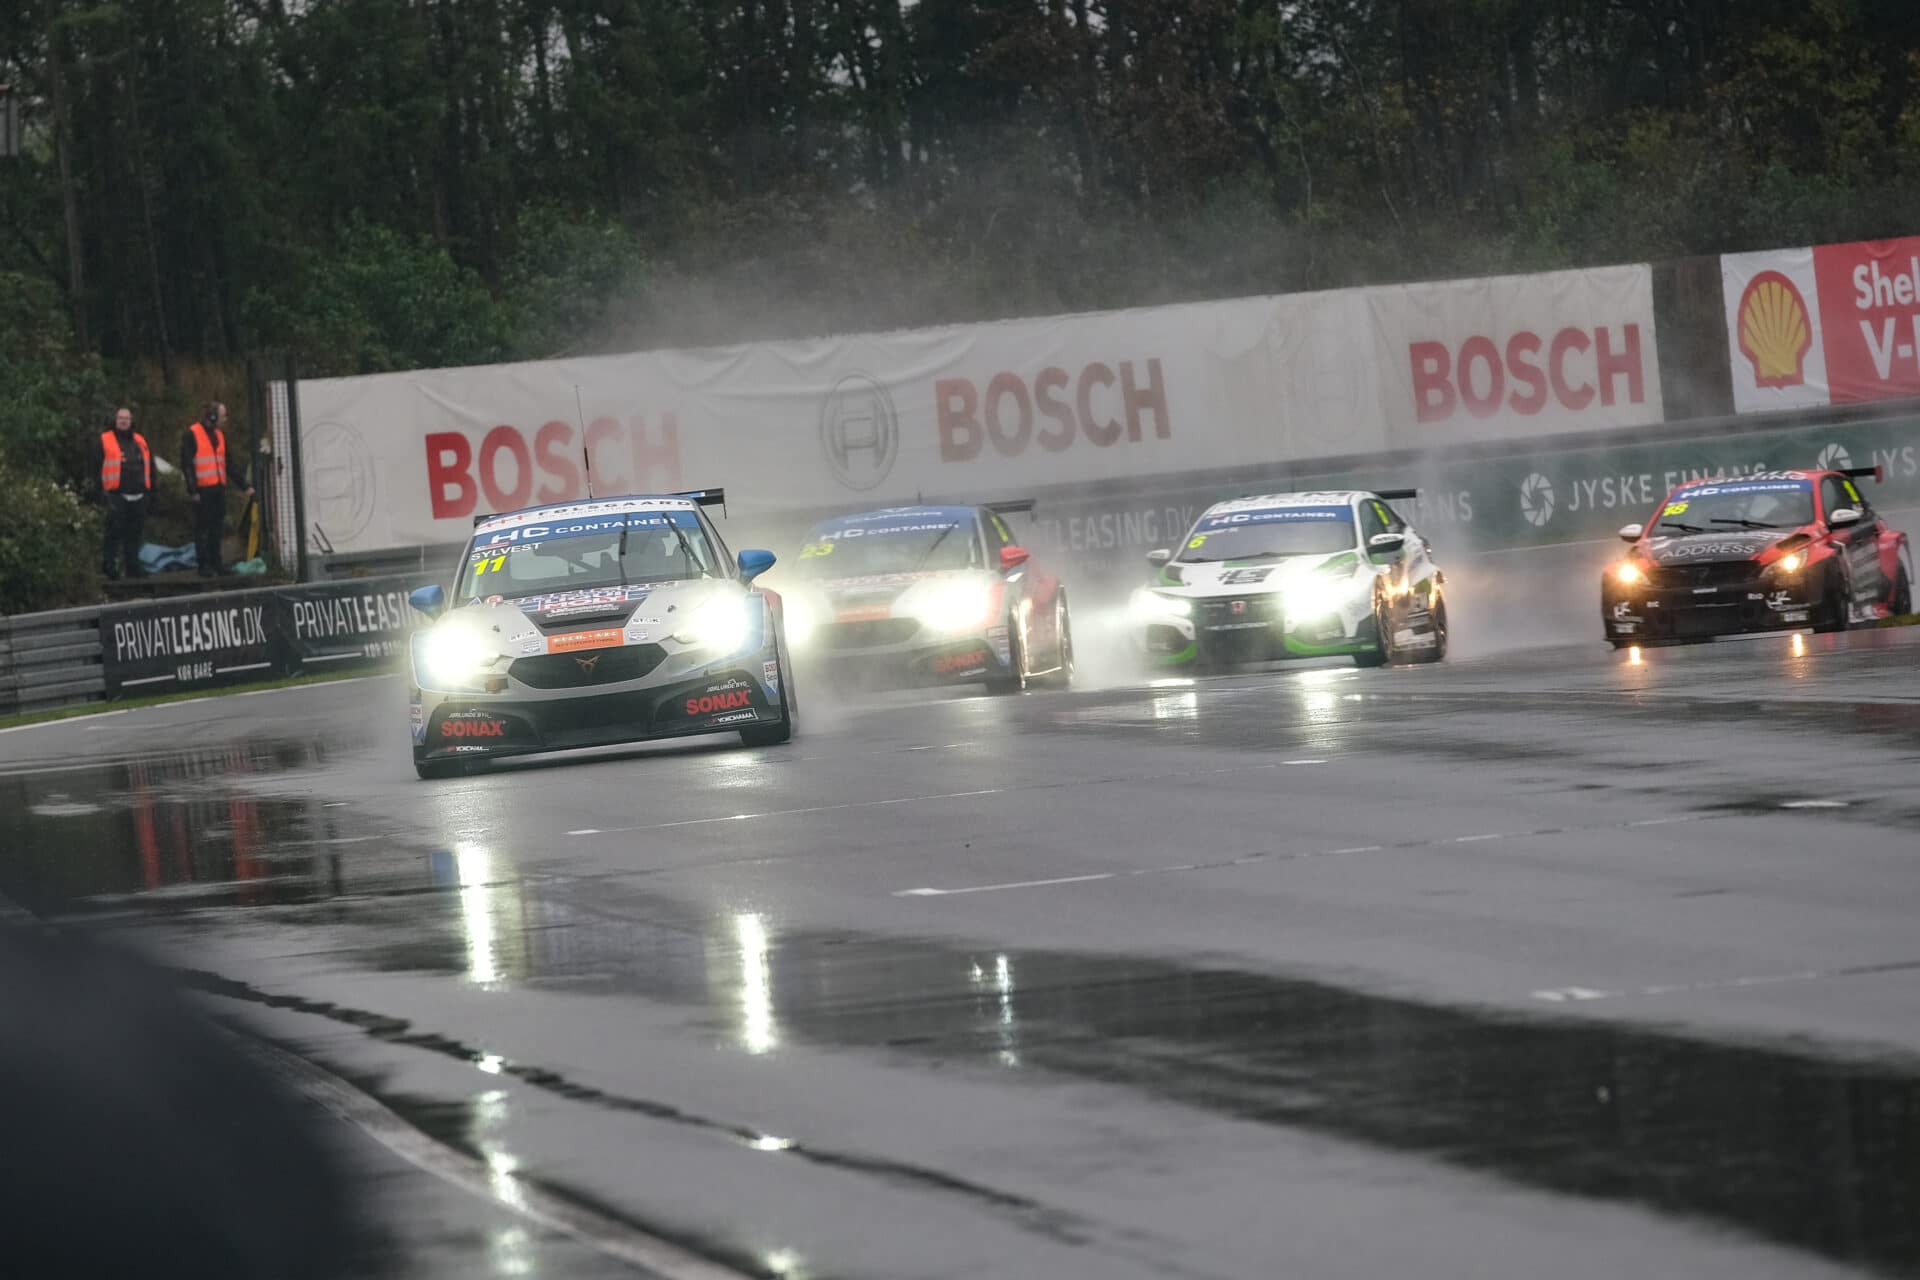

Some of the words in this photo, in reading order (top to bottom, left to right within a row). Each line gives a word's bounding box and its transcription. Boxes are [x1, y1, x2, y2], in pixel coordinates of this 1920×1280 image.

[1854, 256, 1920, 310] Shel
[1409, 323, 1645, 424] BOSCH
[935, 357, 1171, 464] BOSCH
[424, 410, 684, 520] BOSCH
[1568, 474, 1654, 511] JYSKE
[1681, 488, 1720, 498] HC
[1721, 484, 1800, 493] CONTAINER
[1210, 514, 1250, 526] HC
[491, 527, 550, 545] HC
[555, 518, 676, 534] CONTAINER
[820, 529, 864, 541] HC
[470, 542, 542, 561] SYLVEST
[1660, 544, 1755, 558] ADDRESS
[474, 556, 506, 576] 11
[114, 606, 267, 661] PRIVATLEASING.DK
[194, 661, 213, 679] BARE
[687, 690, 750, 715] SONAX
[441, 720, 504, 736] SONAX
